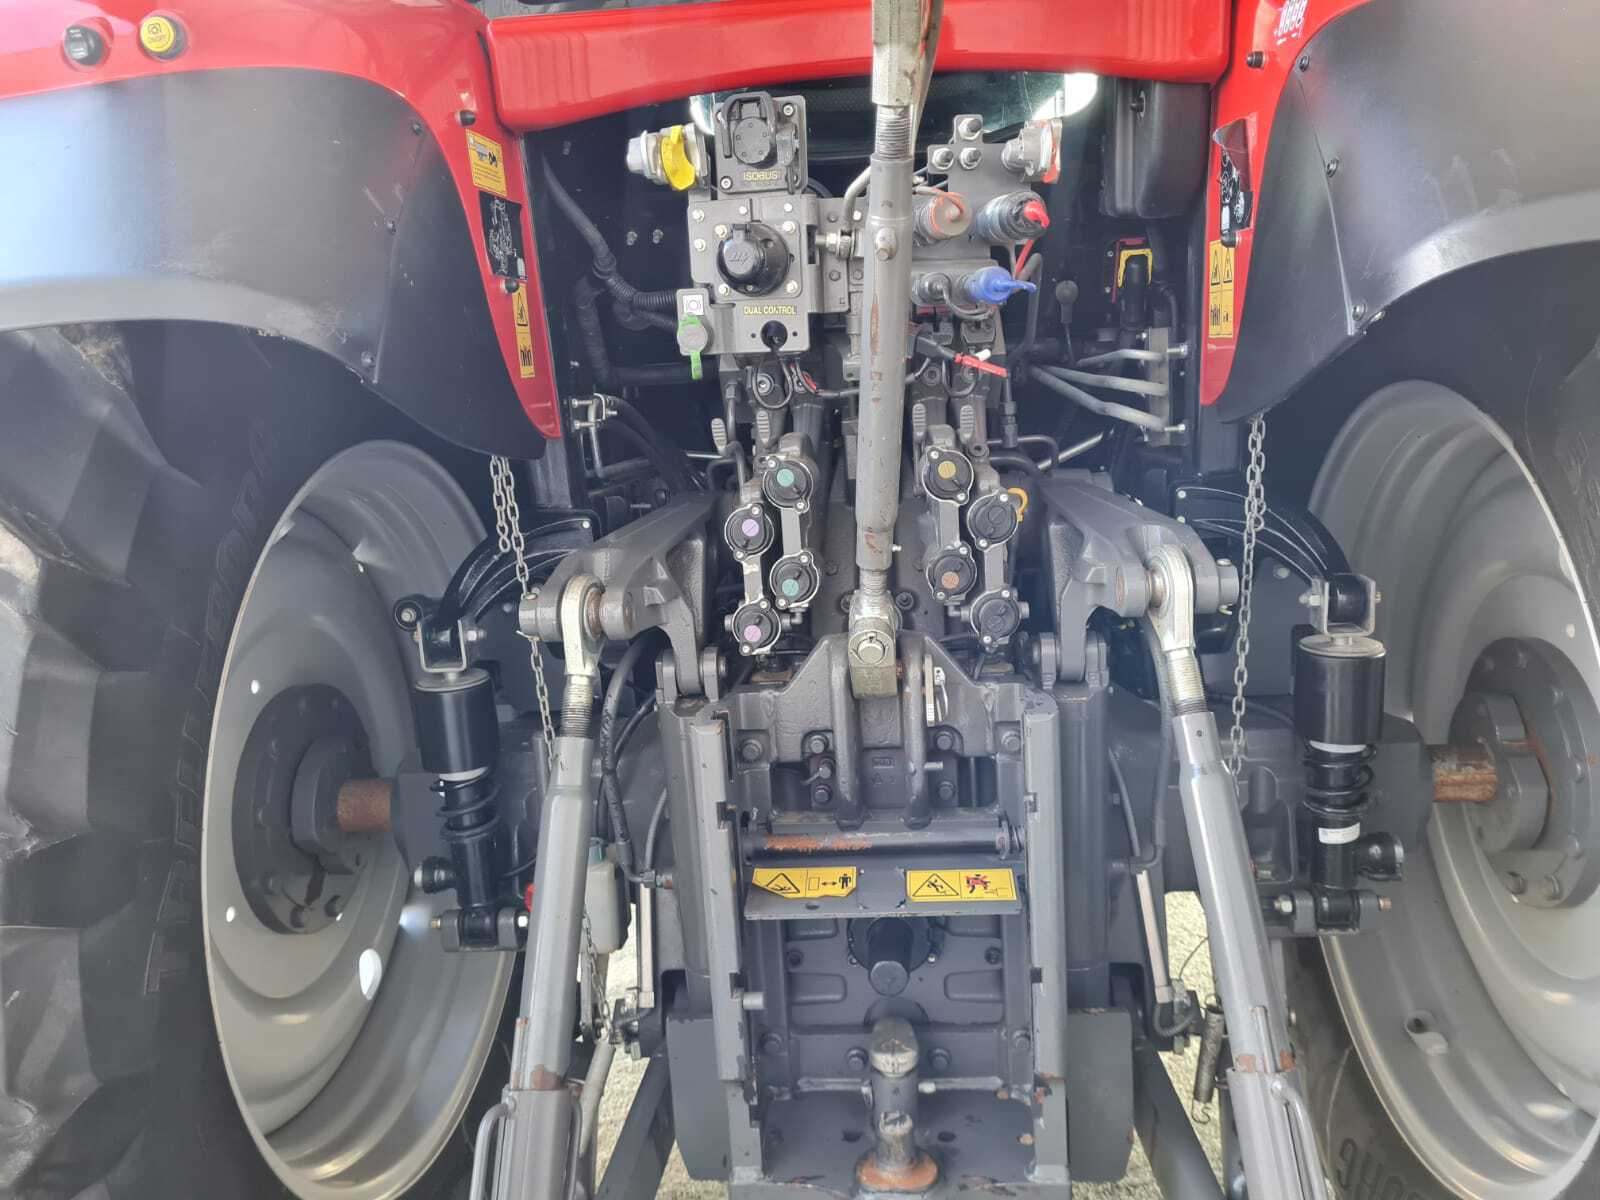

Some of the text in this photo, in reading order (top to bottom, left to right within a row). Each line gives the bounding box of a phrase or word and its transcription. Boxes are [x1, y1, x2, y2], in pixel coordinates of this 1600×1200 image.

[743, 170, 778, 181] ISOBUS
[743, 304, 797, 315] DUAL CONTROL
